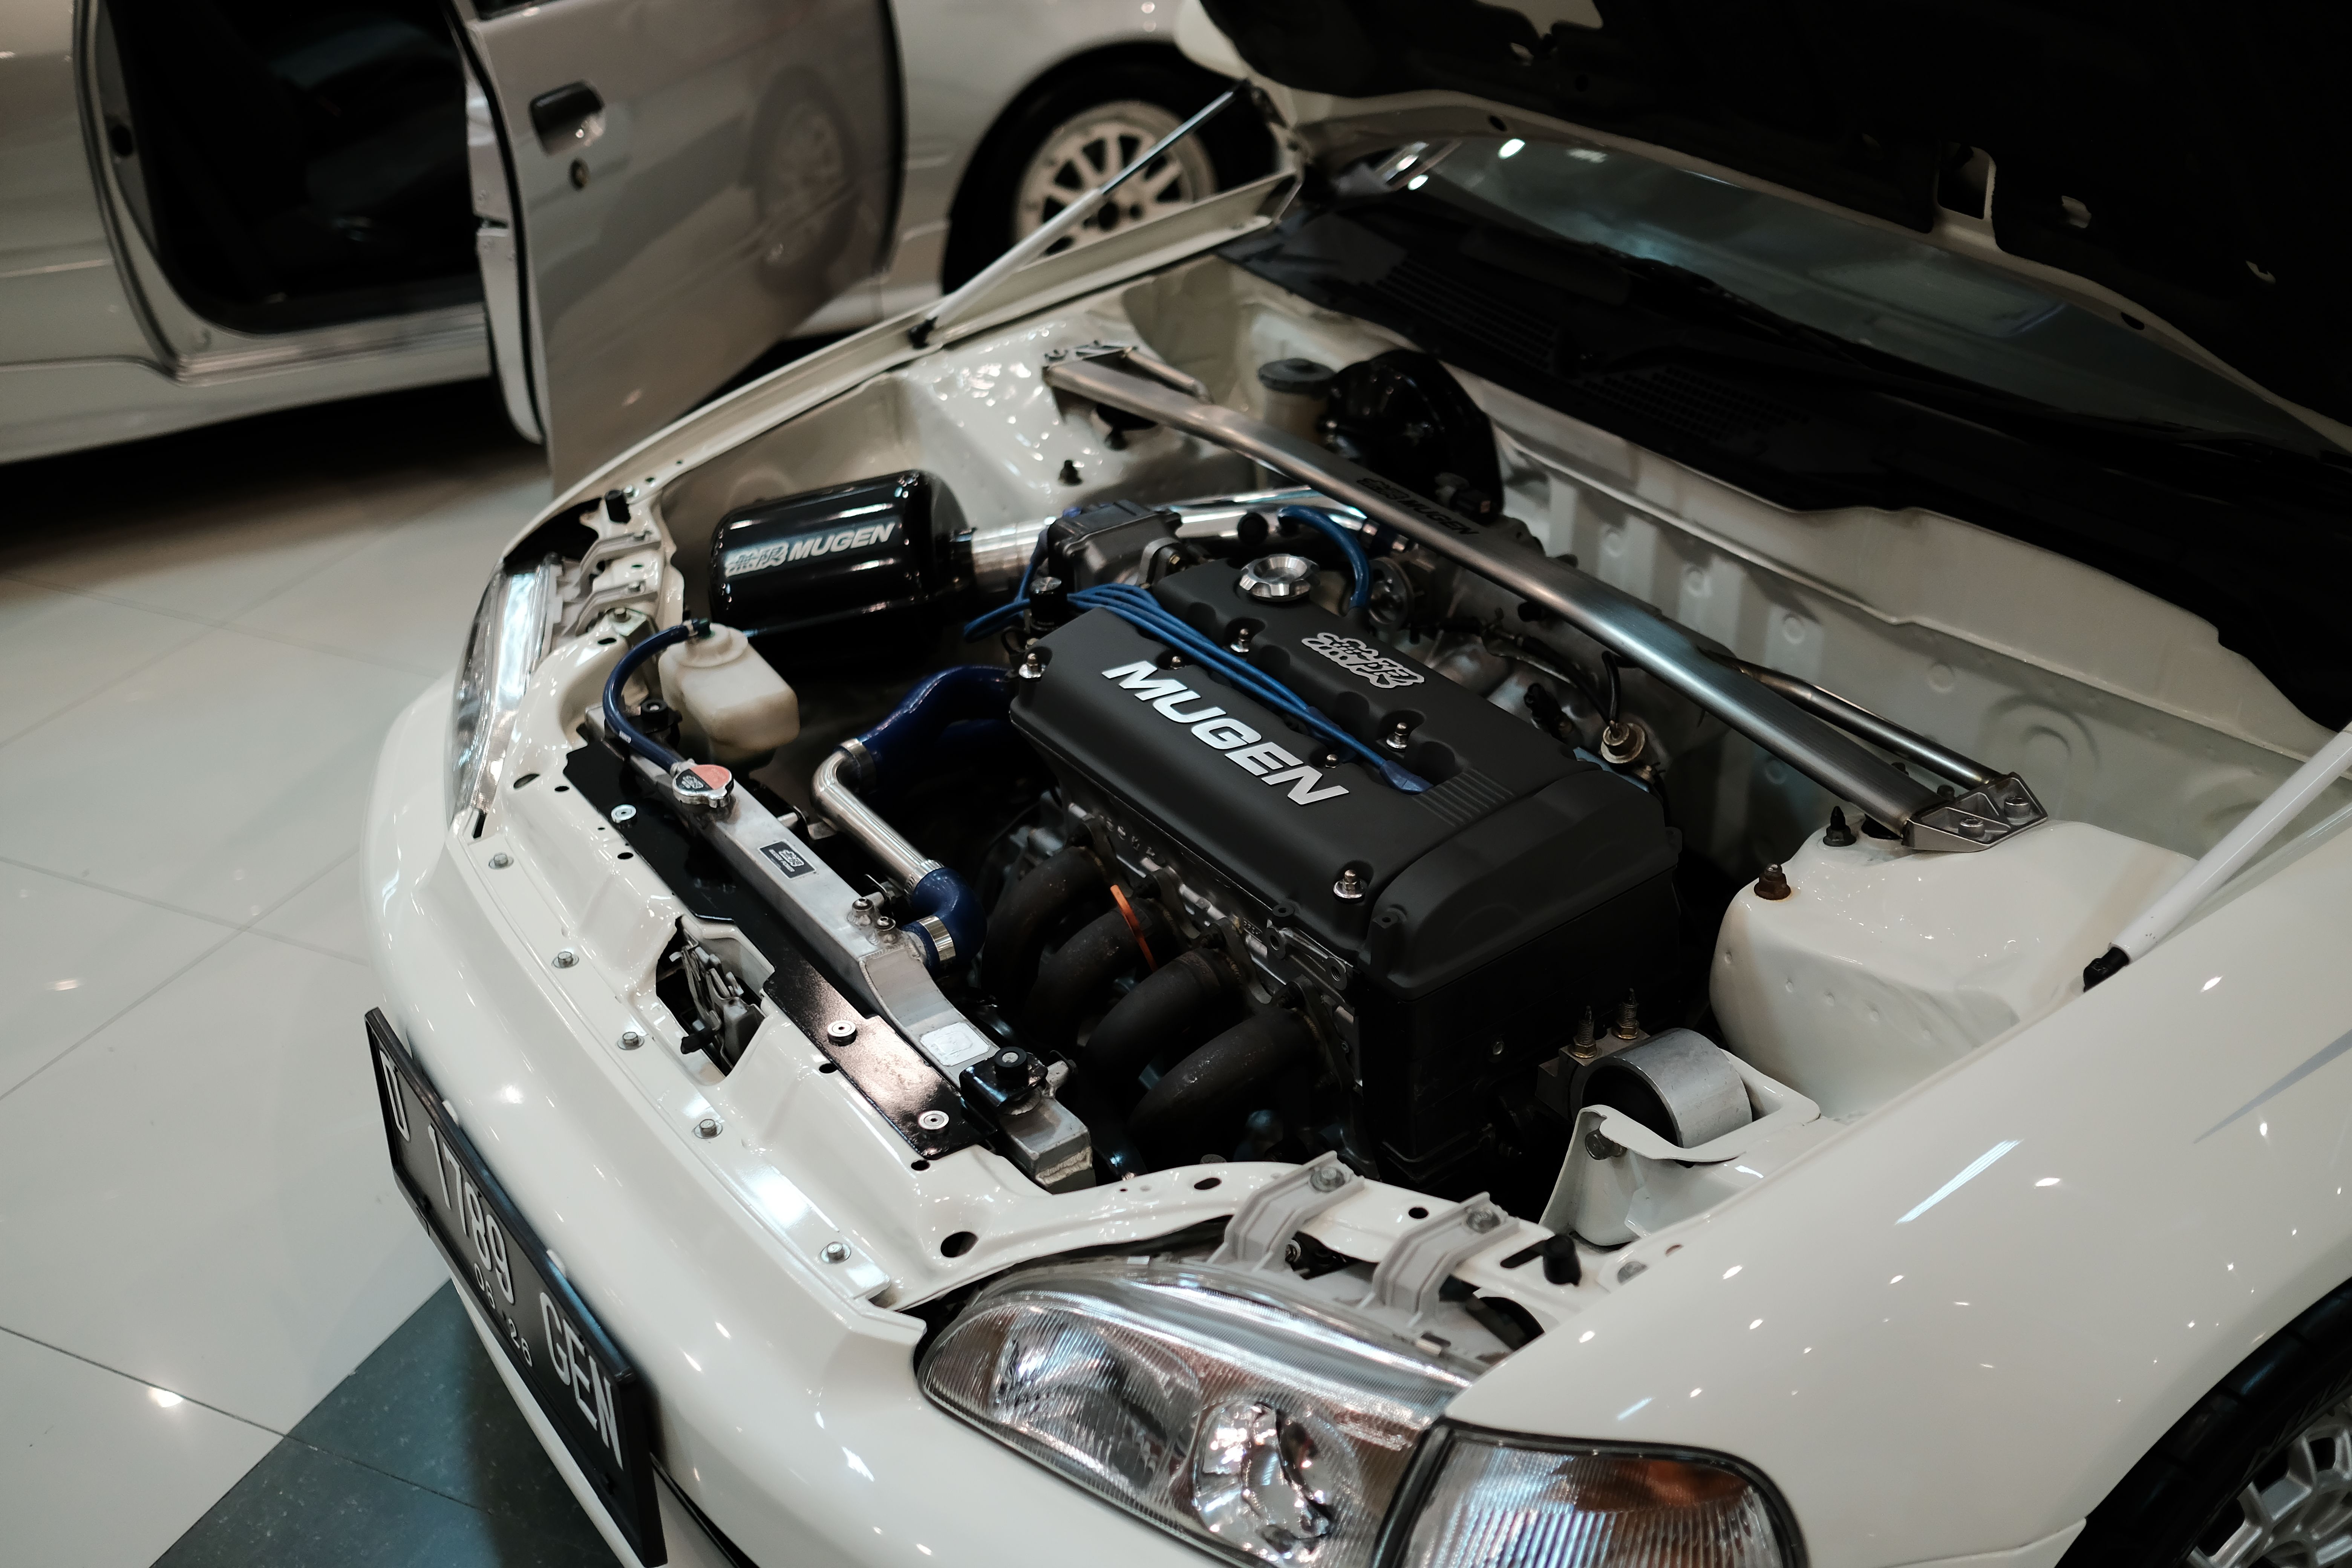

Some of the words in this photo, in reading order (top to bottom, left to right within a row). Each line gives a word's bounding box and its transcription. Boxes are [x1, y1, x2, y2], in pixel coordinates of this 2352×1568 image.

[788, 522, 896, 562] MUGEN
[1397, 499, 1479, 535] MUGEN
[1102, 660, 1349, 805] MUGEN
[428, 1123, 515, 1305] 1789
[539, 1292, 624, 1471] GEN
[474, 1263, 496, 1309] 06
[508, 1318, 533, 1367] 26
